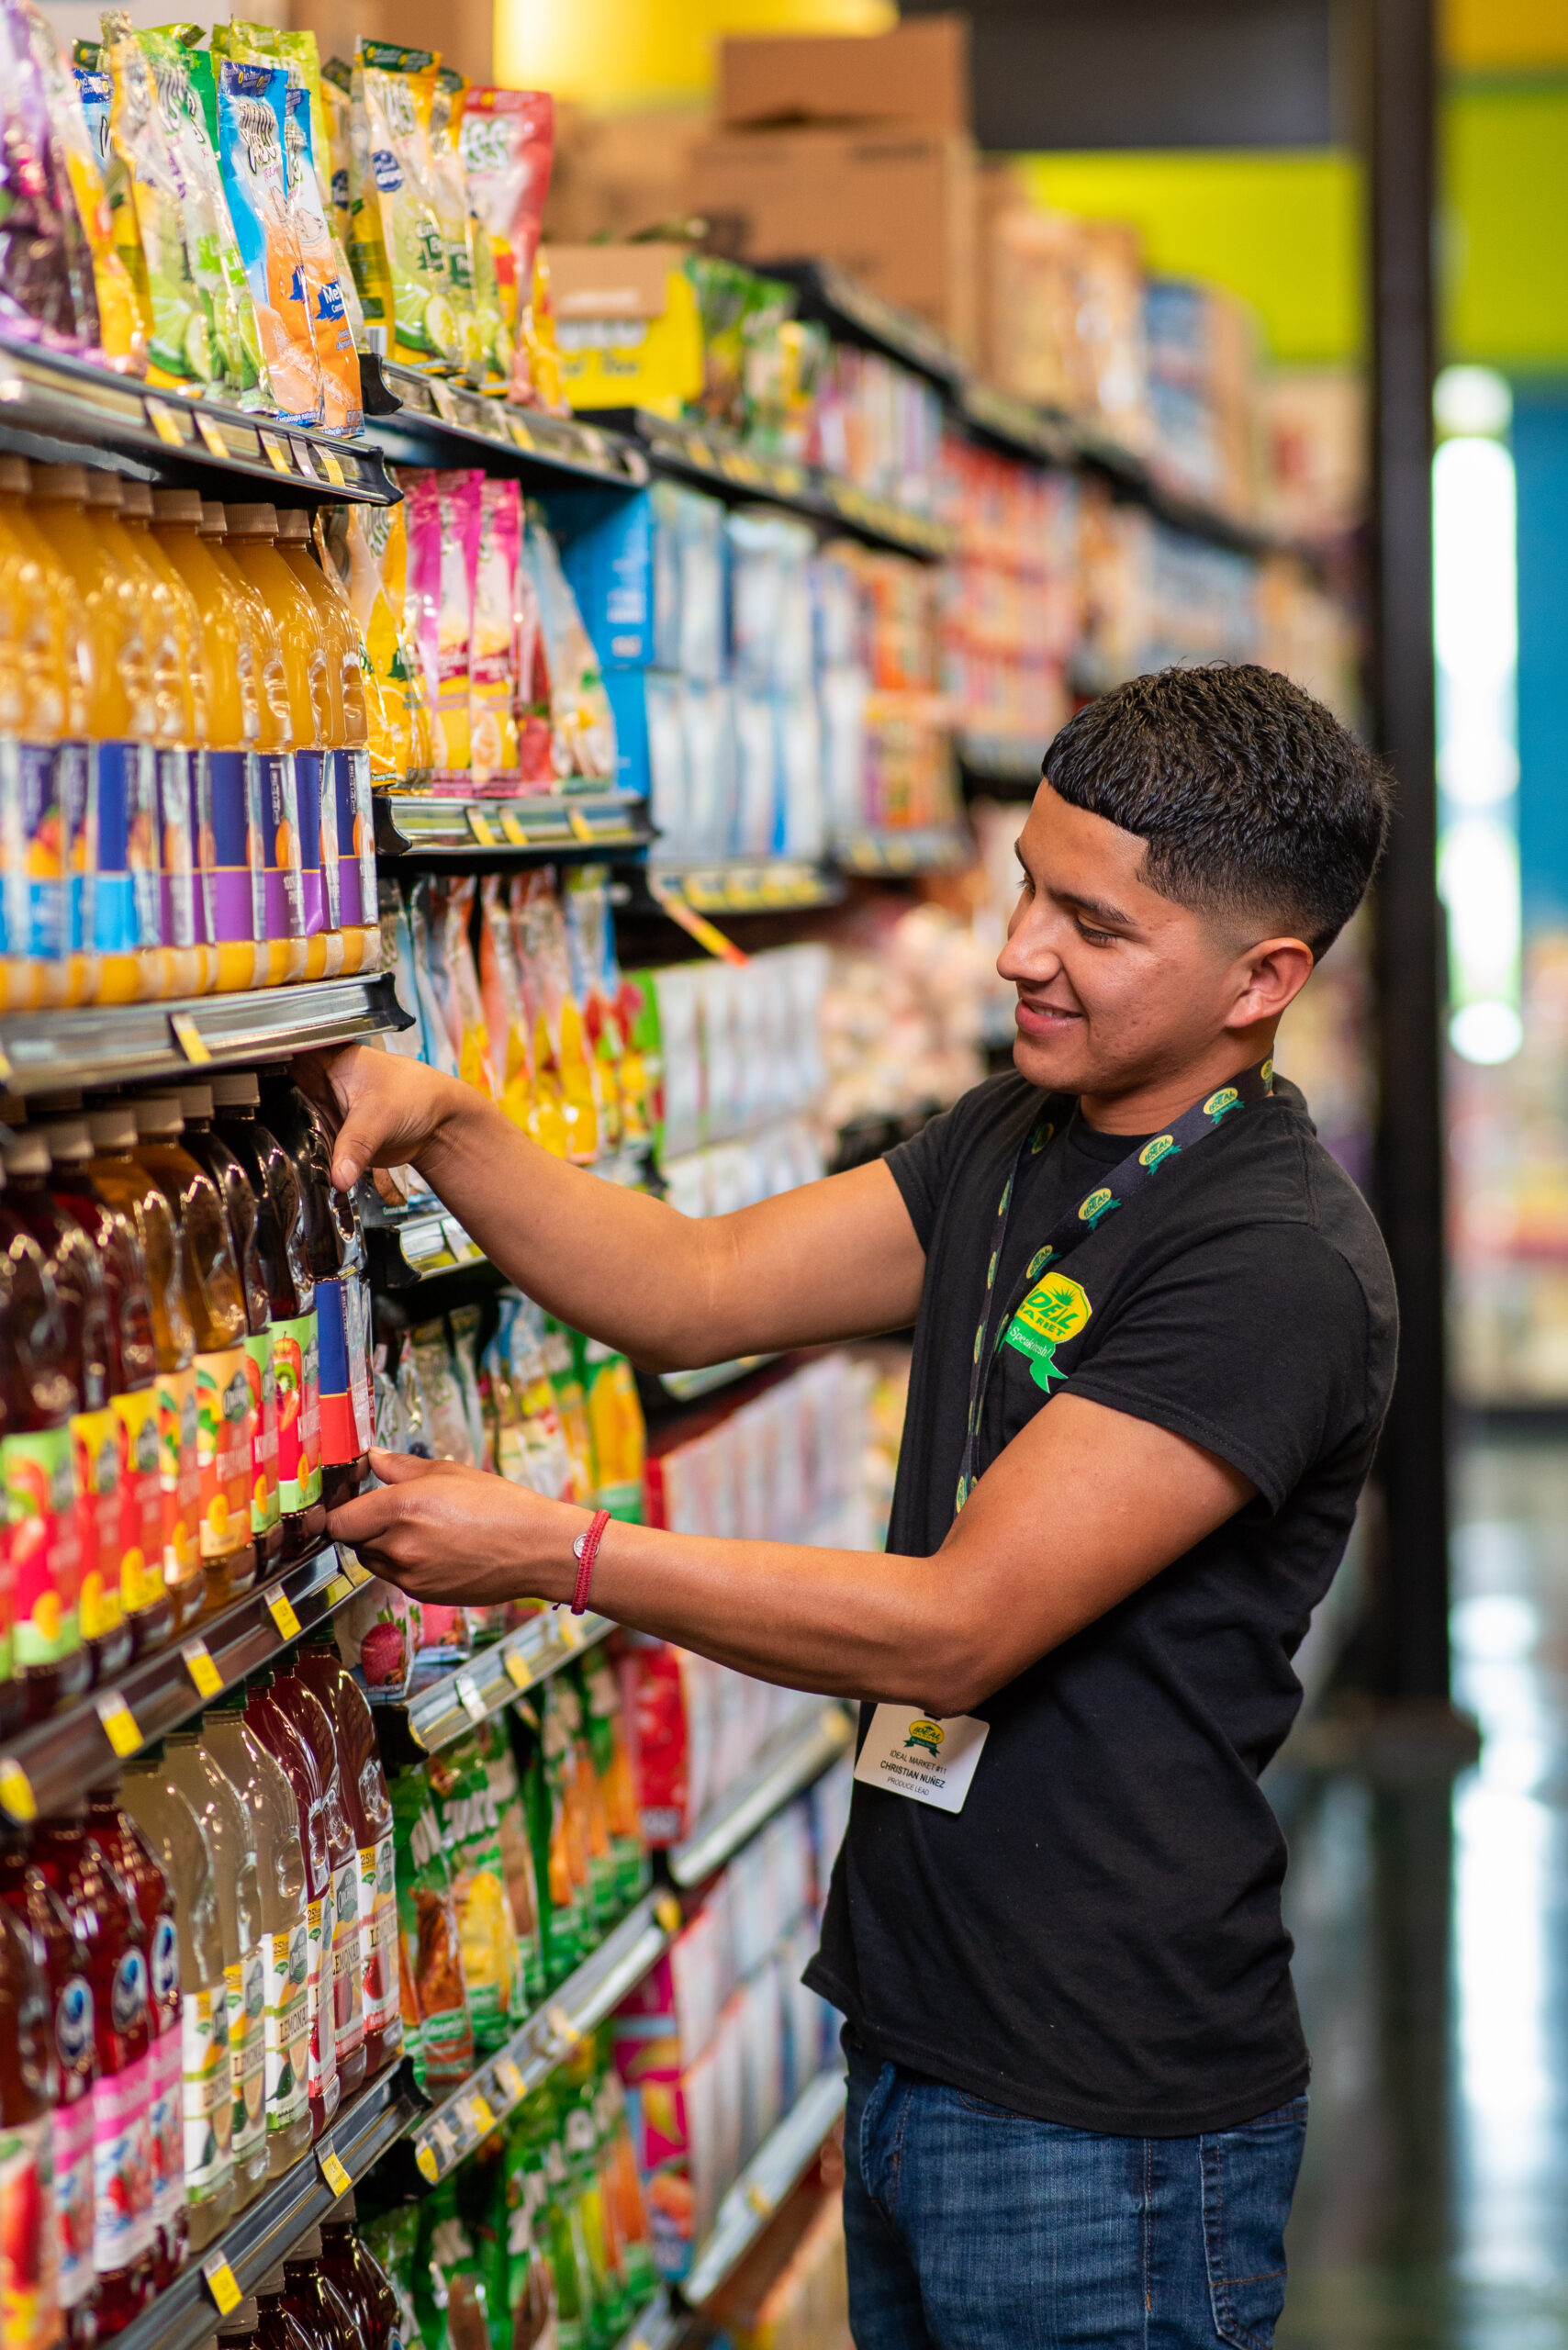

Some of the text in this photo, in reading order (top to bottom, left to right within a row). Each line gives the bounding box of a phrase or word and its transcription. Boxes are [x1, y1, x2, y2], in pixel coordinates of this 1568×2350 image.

[879, 1760, 918, 1780] CHRISTIAN
[890, 1750, 907, 1762] IDEAL
[909, 1756, 935, 1771] MARKET
[887, 1776, 929, 1796] PRODUCE LEAD
